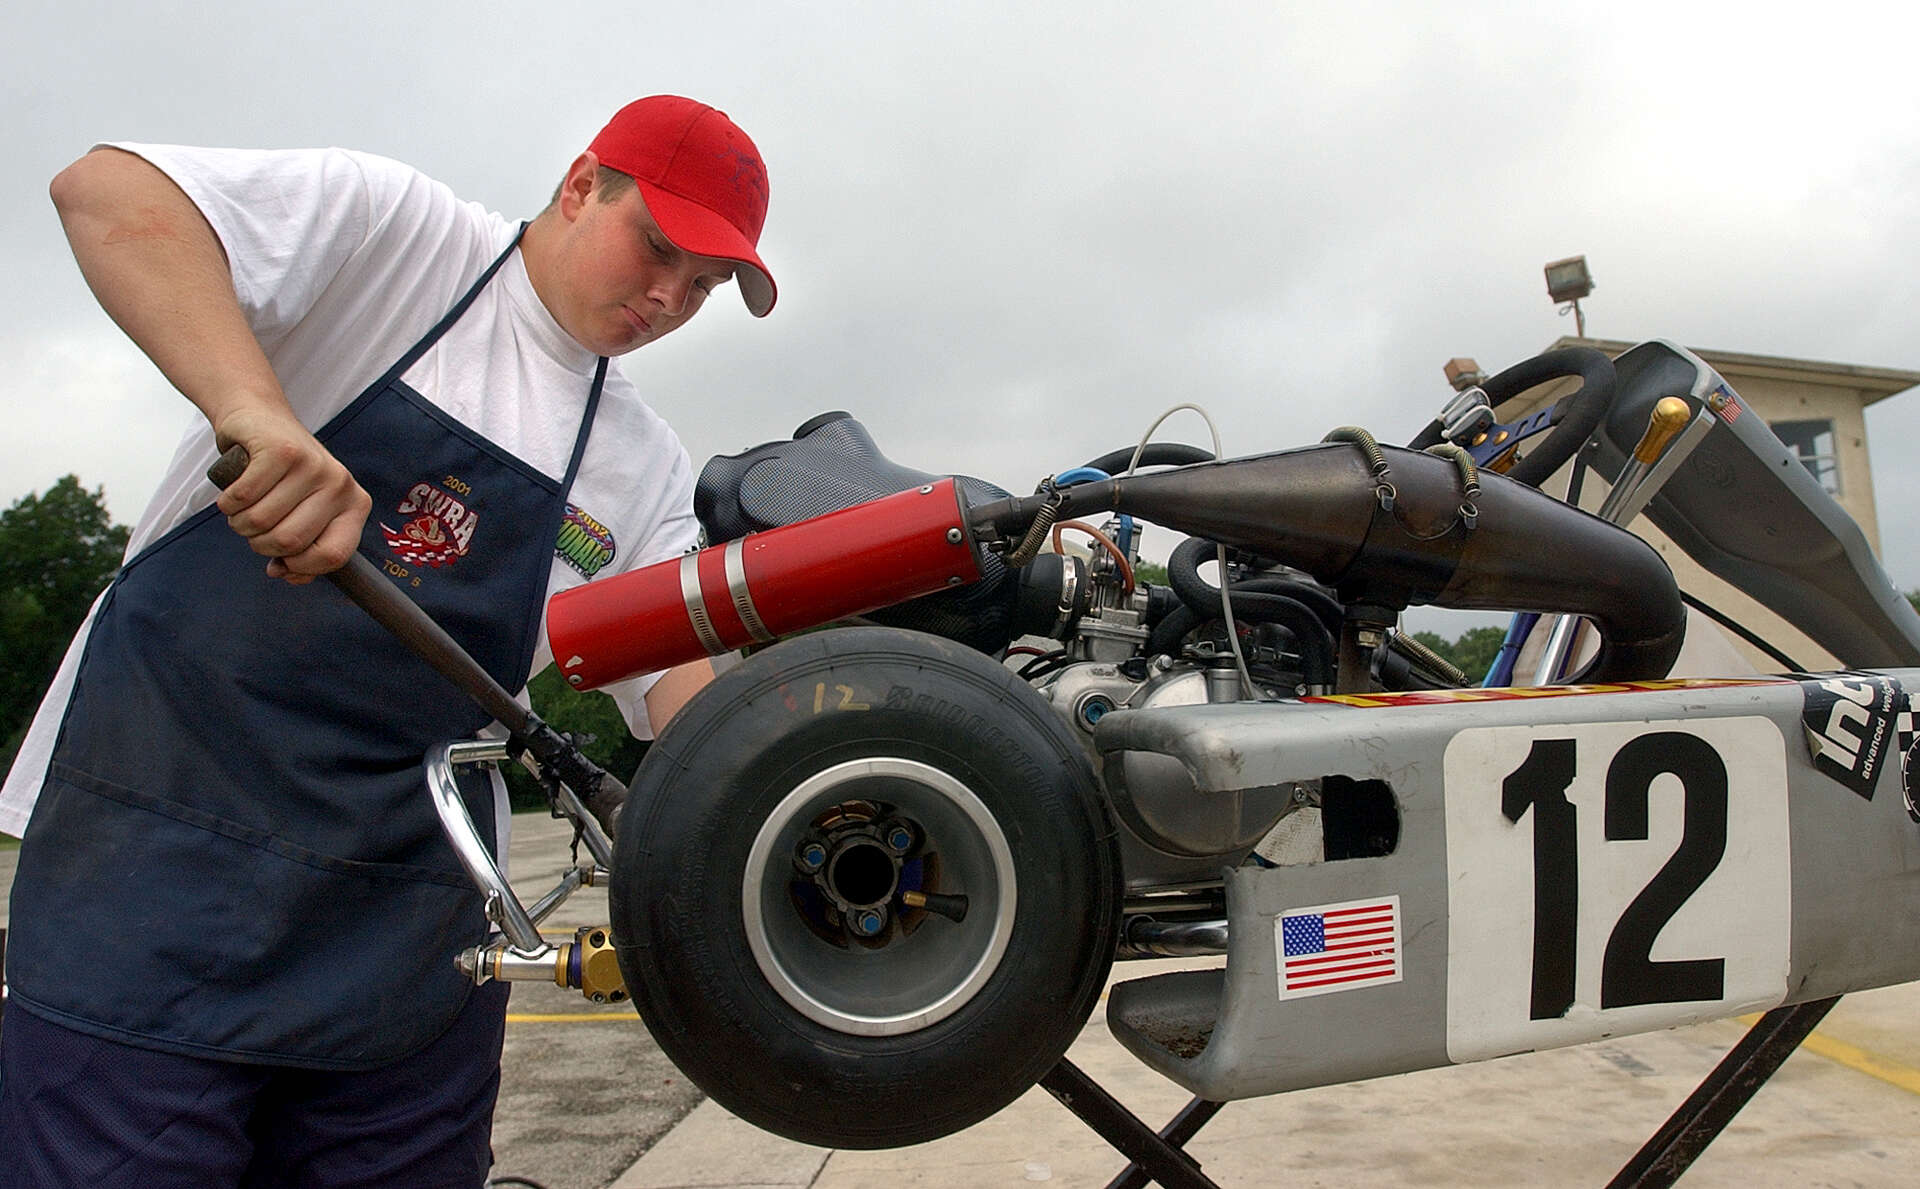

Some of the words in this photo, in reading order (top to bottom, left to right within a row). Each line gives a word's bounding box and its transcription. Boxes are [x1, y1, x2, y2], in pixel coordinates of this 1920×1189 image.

[442, 475, 473, 497] 2001
[398, 481, 480, 552] SWRA
[383, 559, 409, 578] TOP
[813, 682, 870, 715] 12
[1861, 715, 1886, 780] advanced
[1501, 731, 1729, 1021] 12
